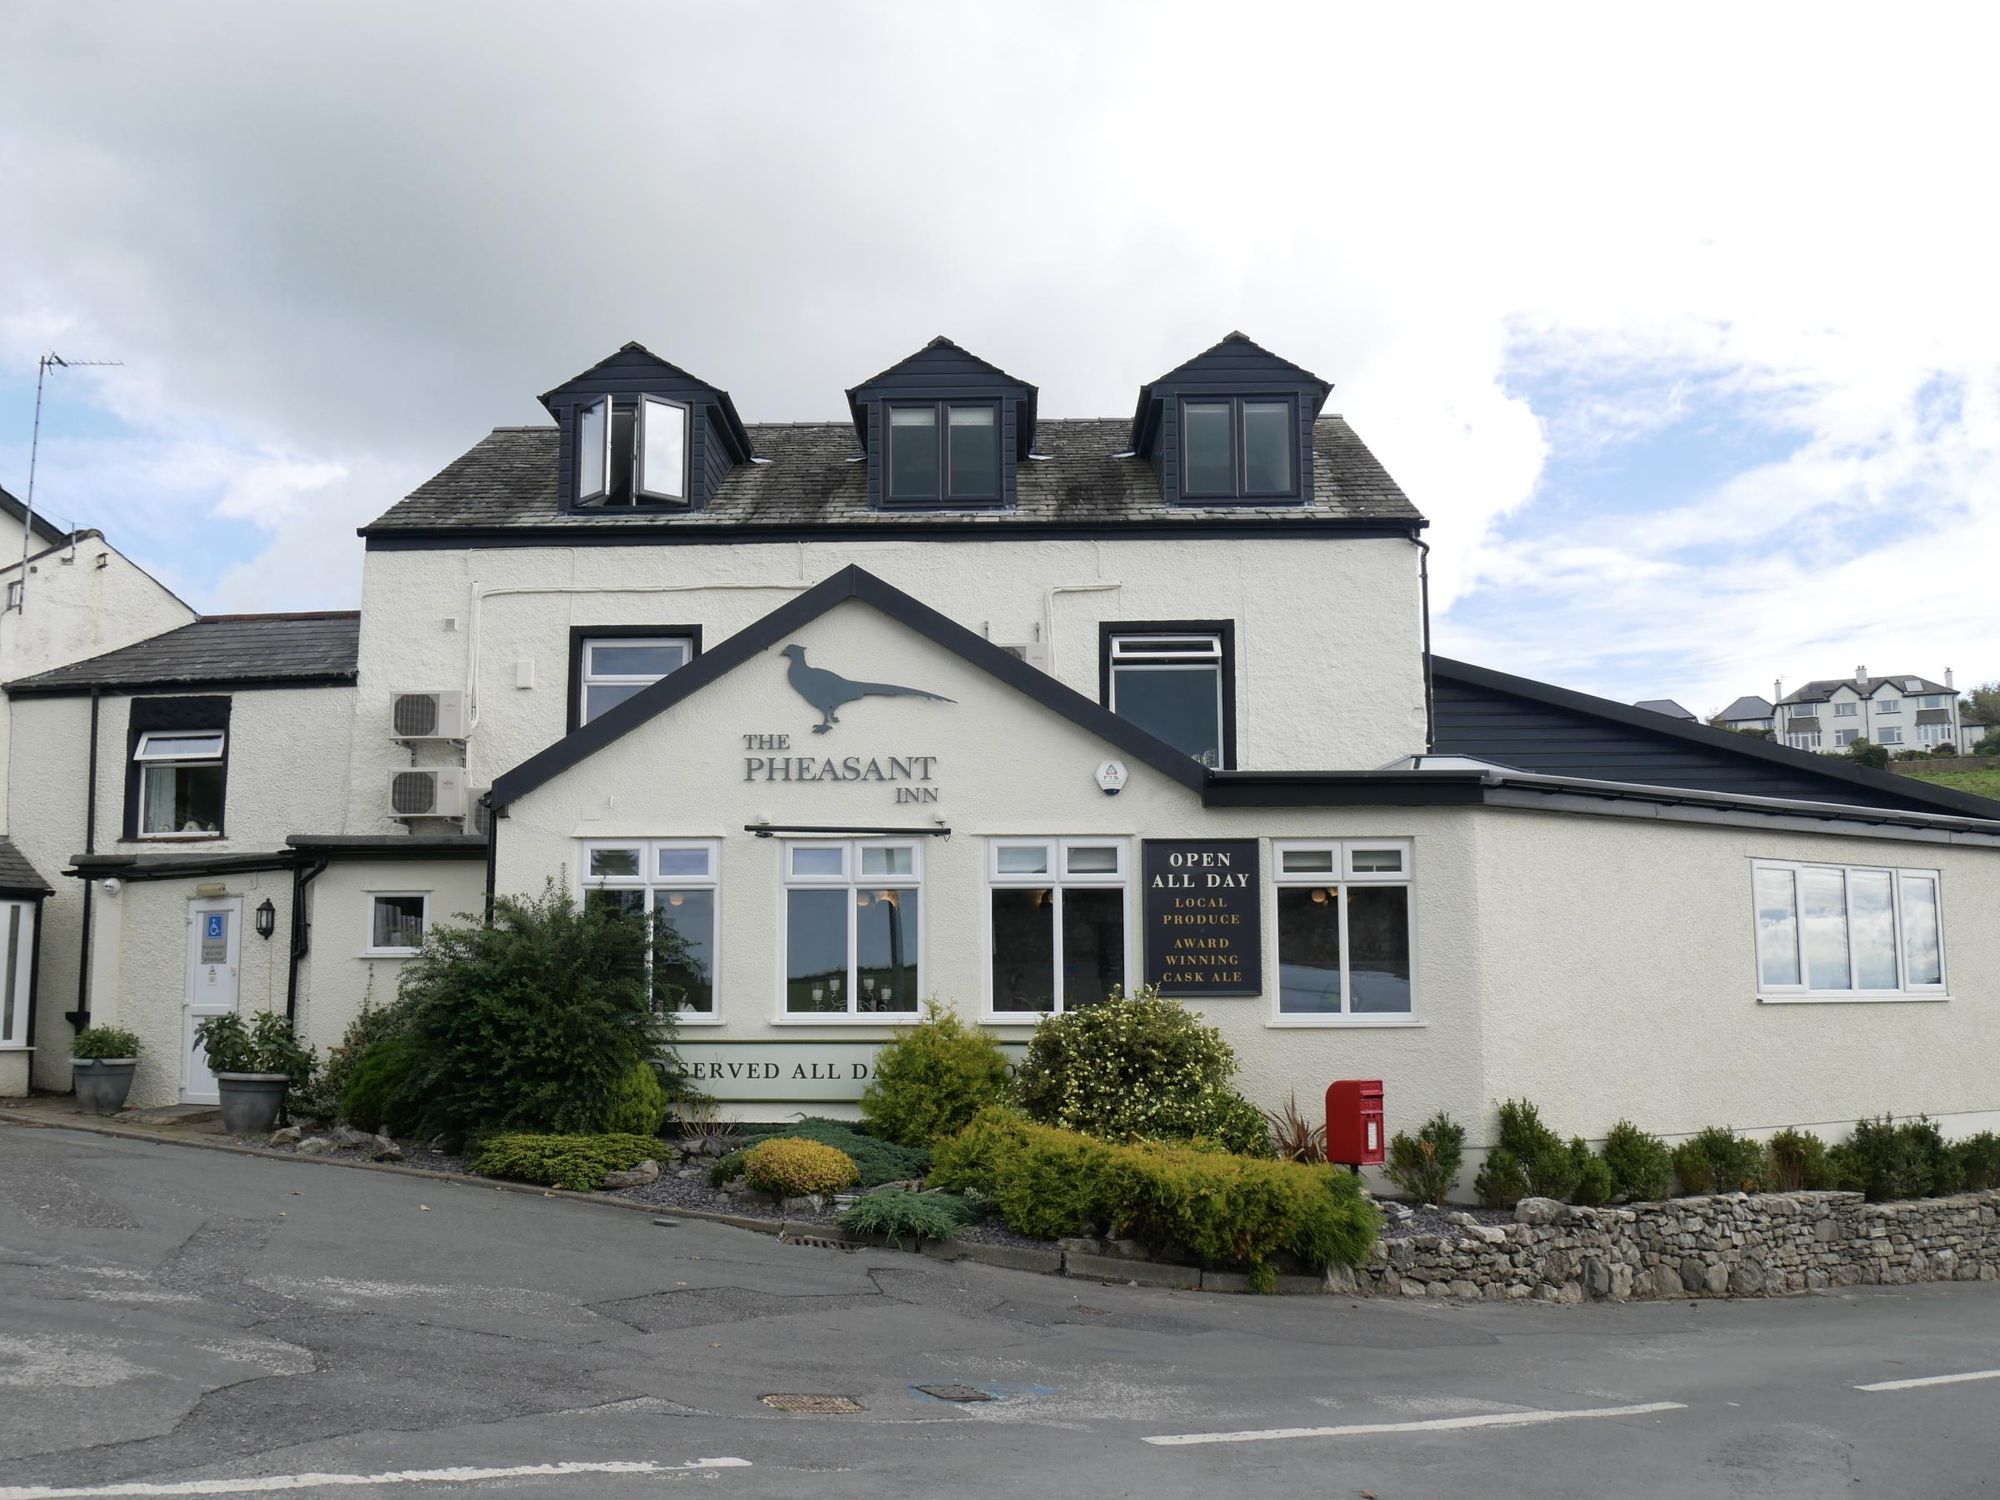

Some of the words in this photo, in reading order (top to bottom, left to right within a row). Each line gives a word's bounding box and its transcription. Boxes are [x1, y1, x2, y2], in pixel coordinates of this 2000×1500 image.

[743, 734, 790, 750] THE
[743, 756, 937, 782] PHEASANT
[895, 787, 939, 804] INN
[1169, 852, 1231, 867] OPEN
[1152, 873, 1195, 888] ALL
[1206, 873, 1250, 888] DAY
[1175, 898, 1228, 908] LOCAL
[1163, 914, 1240, 925] PRODUCE
[1174, 938, 1230, 949] AWARD
[1166, 955, 1239, 965] WINNING
[1162, 972, 1204, 982] CASK
[1211, 972, 1242, 982] ALE
[678, 1062, 780, 1079] SERVED
[791, 1063, 841, 1080] ALL
